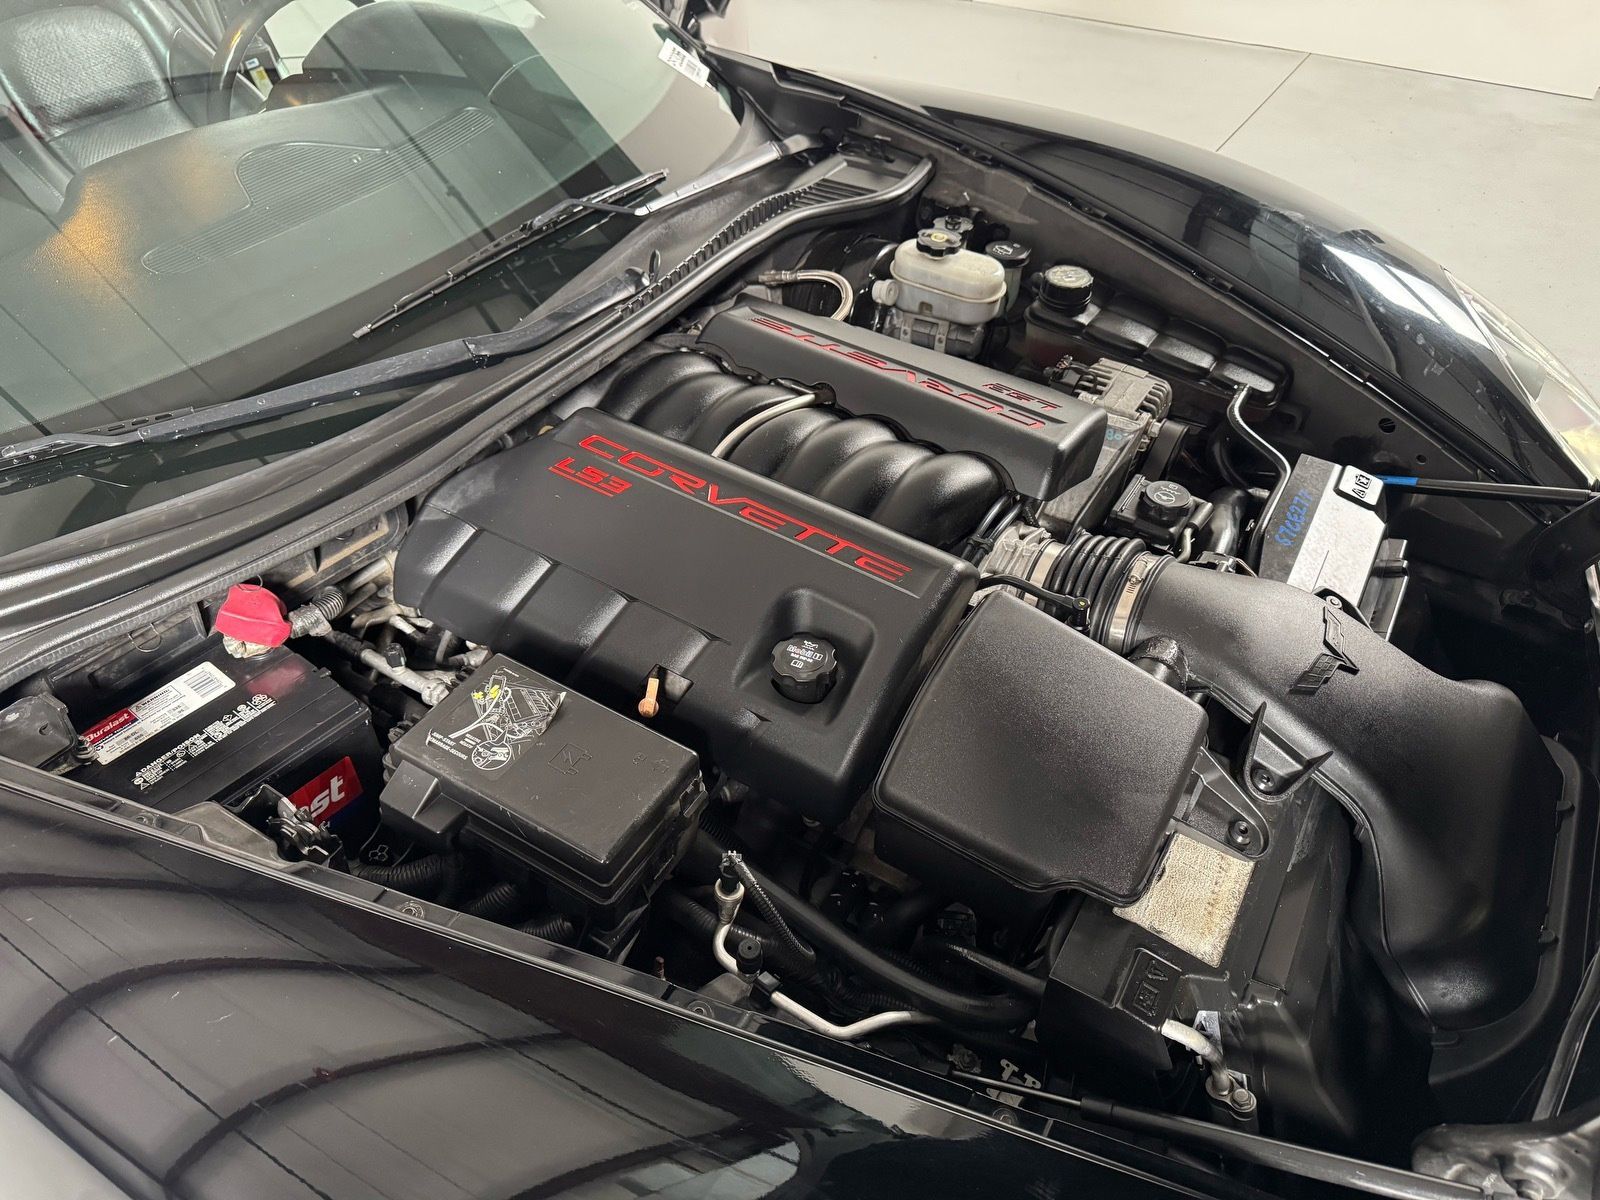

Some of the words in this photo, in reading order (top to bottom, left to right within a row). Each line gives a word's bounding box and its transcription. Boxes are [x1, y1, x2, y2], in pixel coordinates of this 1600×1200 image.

[751, 317, 1046, 429] CORVETTE
[983, 383, 1062, 411] LS3
[550, 457, 632, 496] LS3
[578, 434, 912, 581] CORVETTE
[85, 712, 130, 742] Duralast
